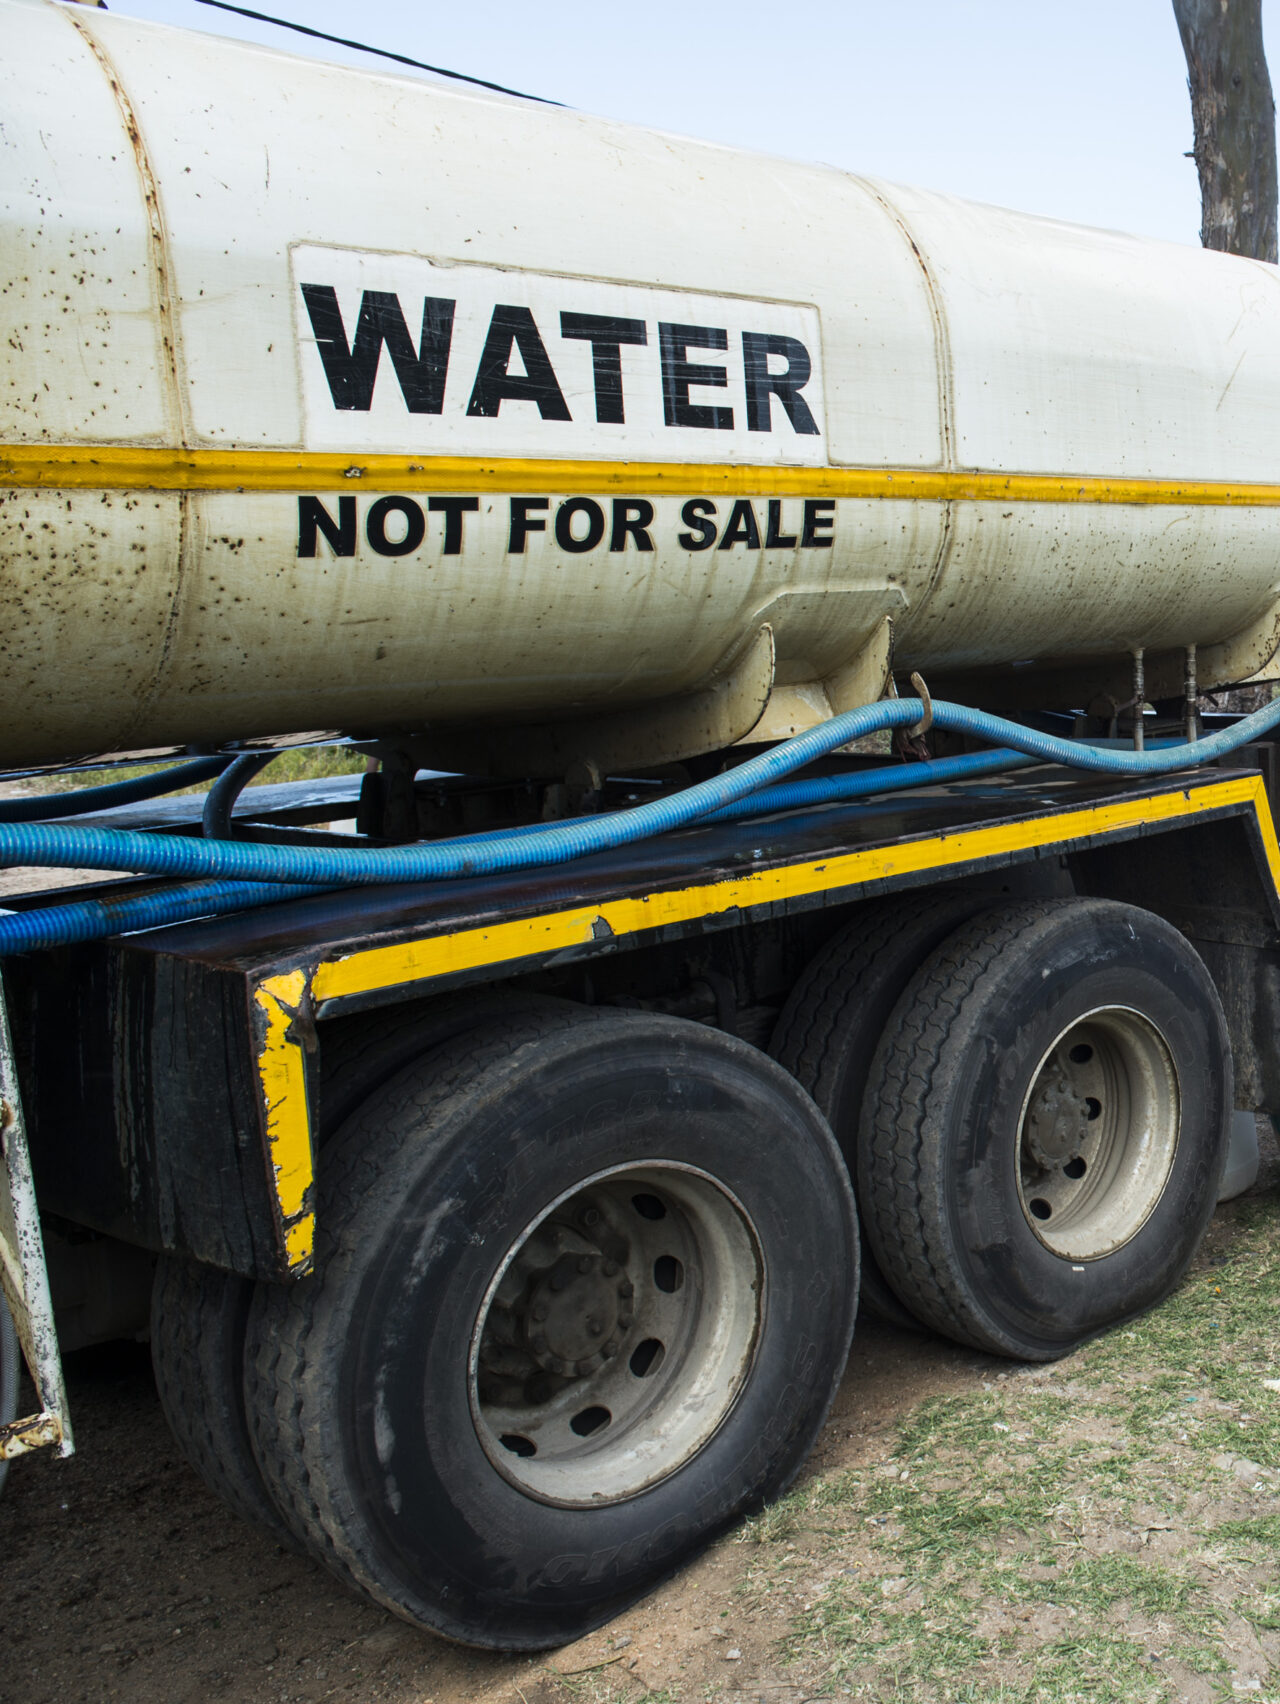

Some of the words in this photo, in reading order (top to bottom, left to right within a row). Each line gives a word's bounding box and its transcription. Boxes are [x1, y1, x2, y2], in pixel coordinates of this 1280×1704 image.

[301, 283, 821, 435] WATER
[298, 495, 479, 557] NOT
[508, 497, 654, 554] FOR
[678, 499, 836, 551] SALE
